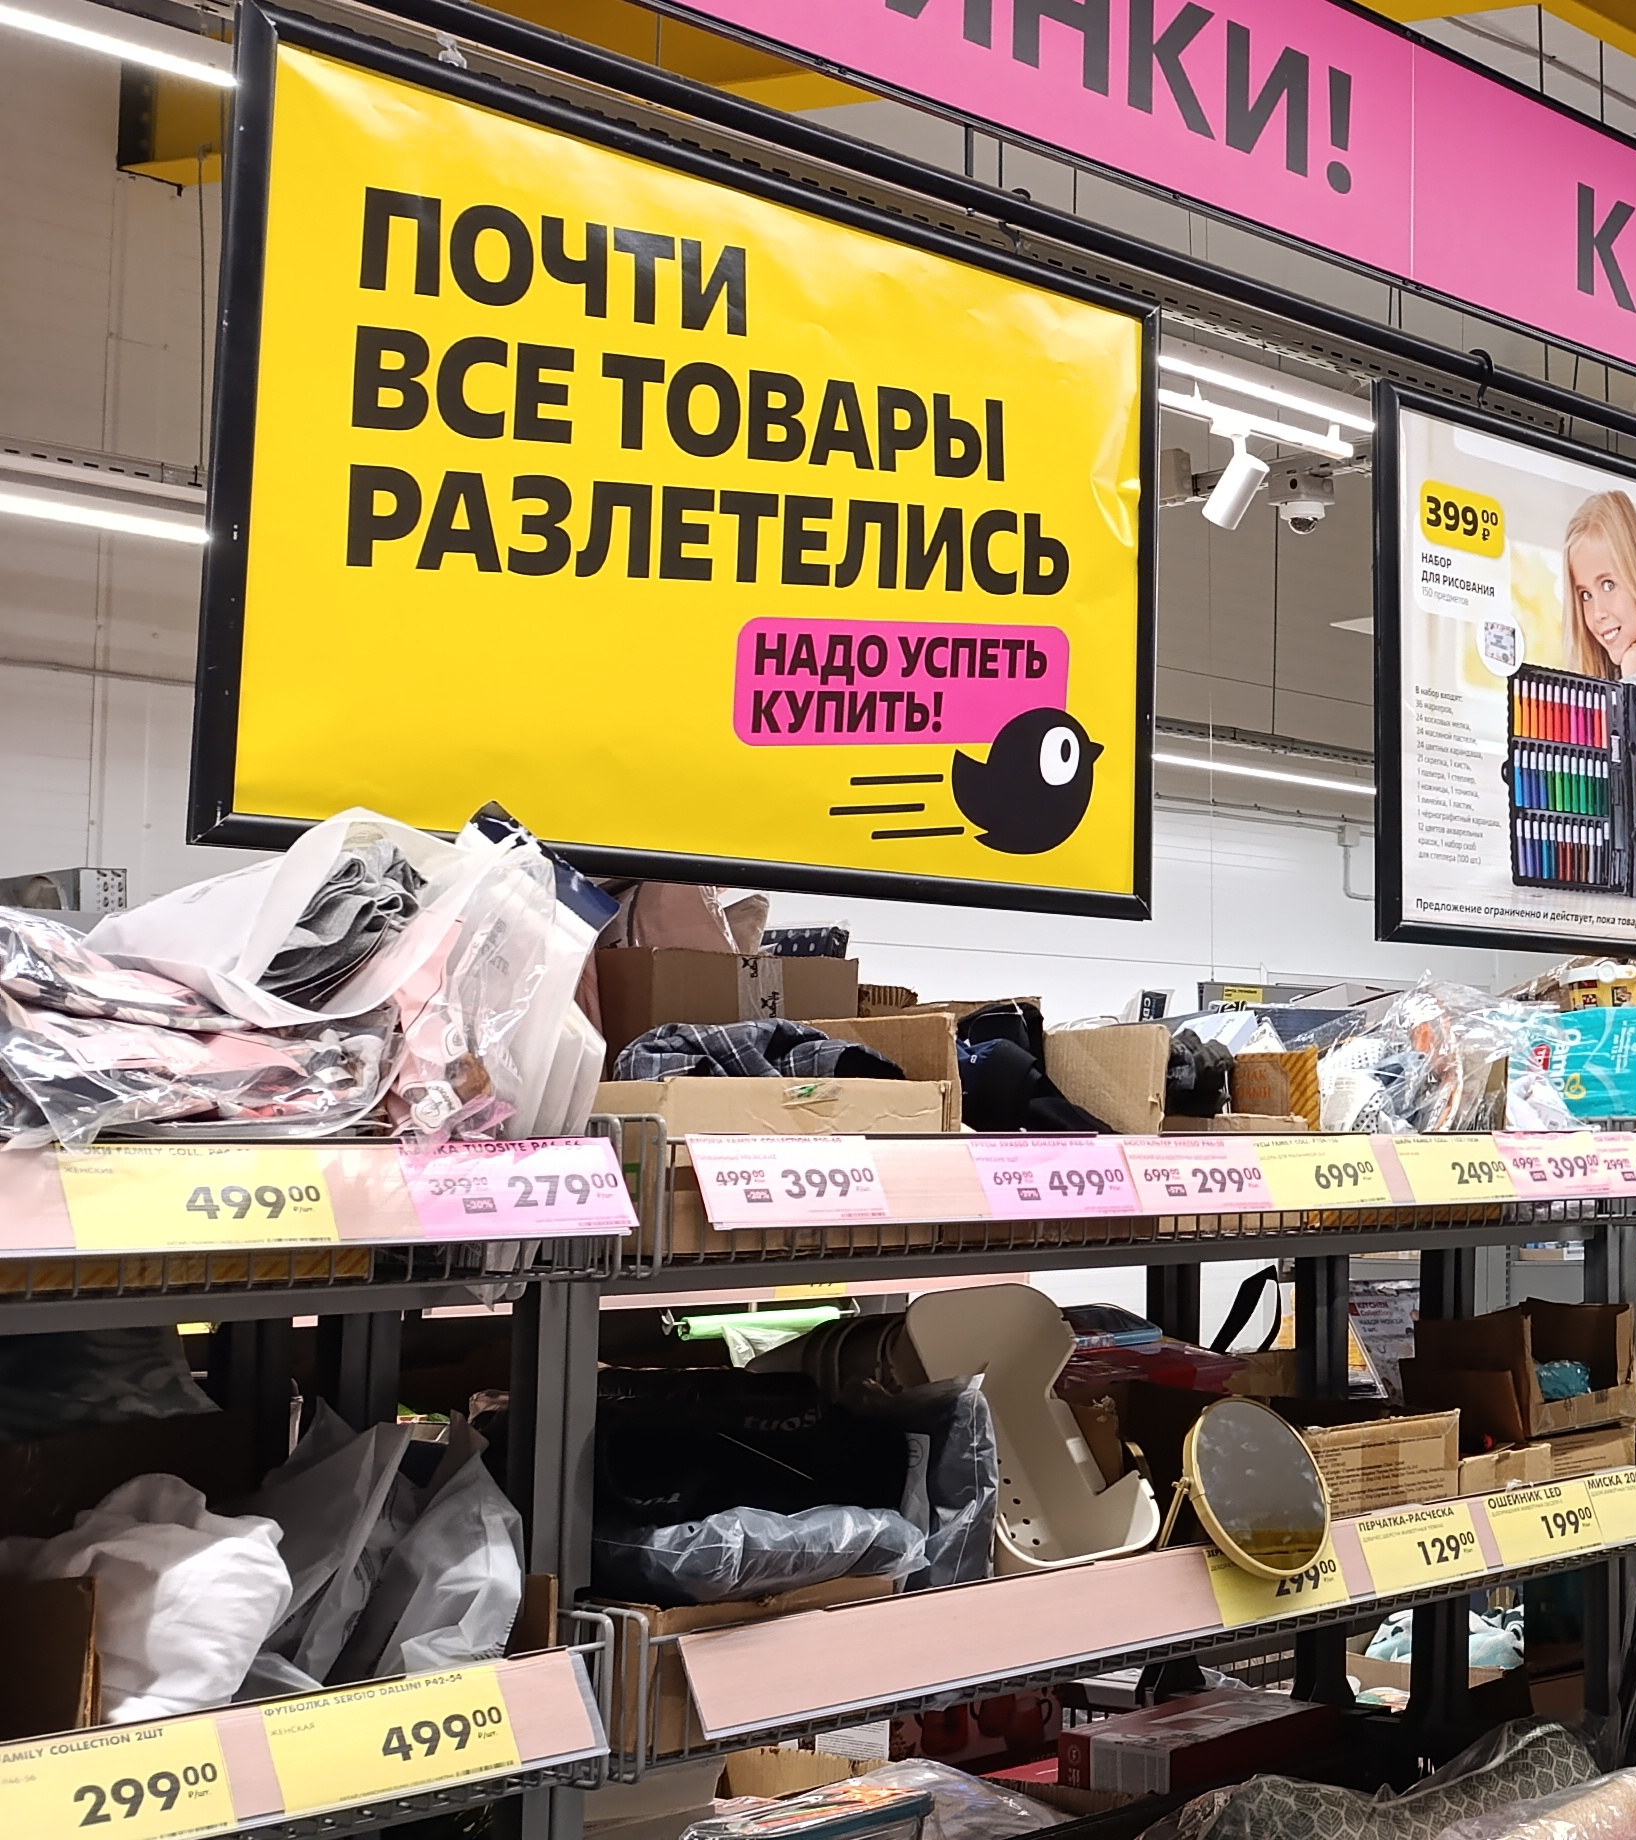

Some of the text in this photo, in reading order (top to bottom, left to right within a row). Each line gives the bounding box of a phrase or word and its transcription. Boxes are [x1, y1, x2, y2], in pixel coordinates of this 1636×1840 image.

[885, 0, 1353, 194] НКИ!
[359, 188, 747, 337] ПОЧТИ
[351, 326, 1005, 481] ВСЕ ТОВАРЫ
[346, 466, 1070, 597] РАЗЛЕТЕЛИСЬ
[1422, 552, 1452, 569] НАБОР
[1421, 570, 1495, 597] ДЛЯ РИСОВАНИЯ
[1422, 587, 1469, 606] 150 предметов
[753, 632, 1048, 684] НАДО УСПЕТЬ
[751, 689, 942, 734] КУПИТЬ!
[1416, 898, 1482, 914] Предложение
[1484, 906, 1540, 918] ограниченно
[1550, 911, 1594, 925] действует,
[1596, 915, 1615, 924] пока
[1587, 1474, 1623, 1489] МИСКА
[1487, 1486, 1561, 1509] ОШЕЙНИК LED
[1359, 1507, 1454, 1532] ПЕРЧАТКА-РАСЧЕСКА
[264, 1673, 463, 1717] ФУТБОЛКА SERGIO DALLINI Р42-54
[270, 1722, 316, 1737] ЖЕНСКАЯ
[0, 1728, 164, 1763] AMILY COLLECTION 2ШТ
